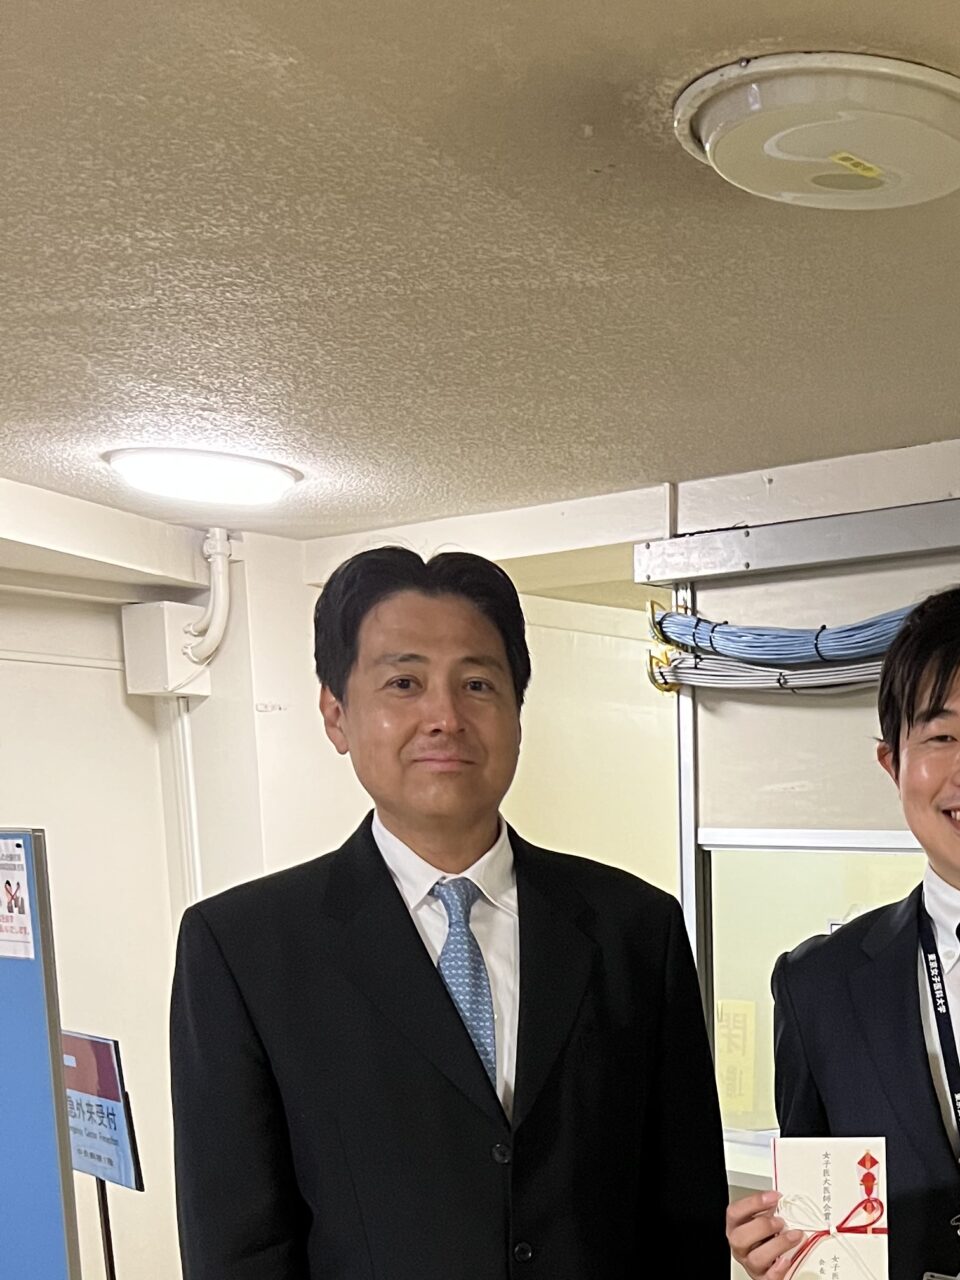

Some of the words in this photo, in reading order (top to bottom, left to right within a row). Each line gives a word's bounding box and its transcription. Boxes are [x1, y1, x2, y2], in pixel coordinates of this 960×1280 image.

[927, 953, 947, 1014] 東京女子医科大学
[822, 1151, 832, 1221] 女子医大医師会賞
